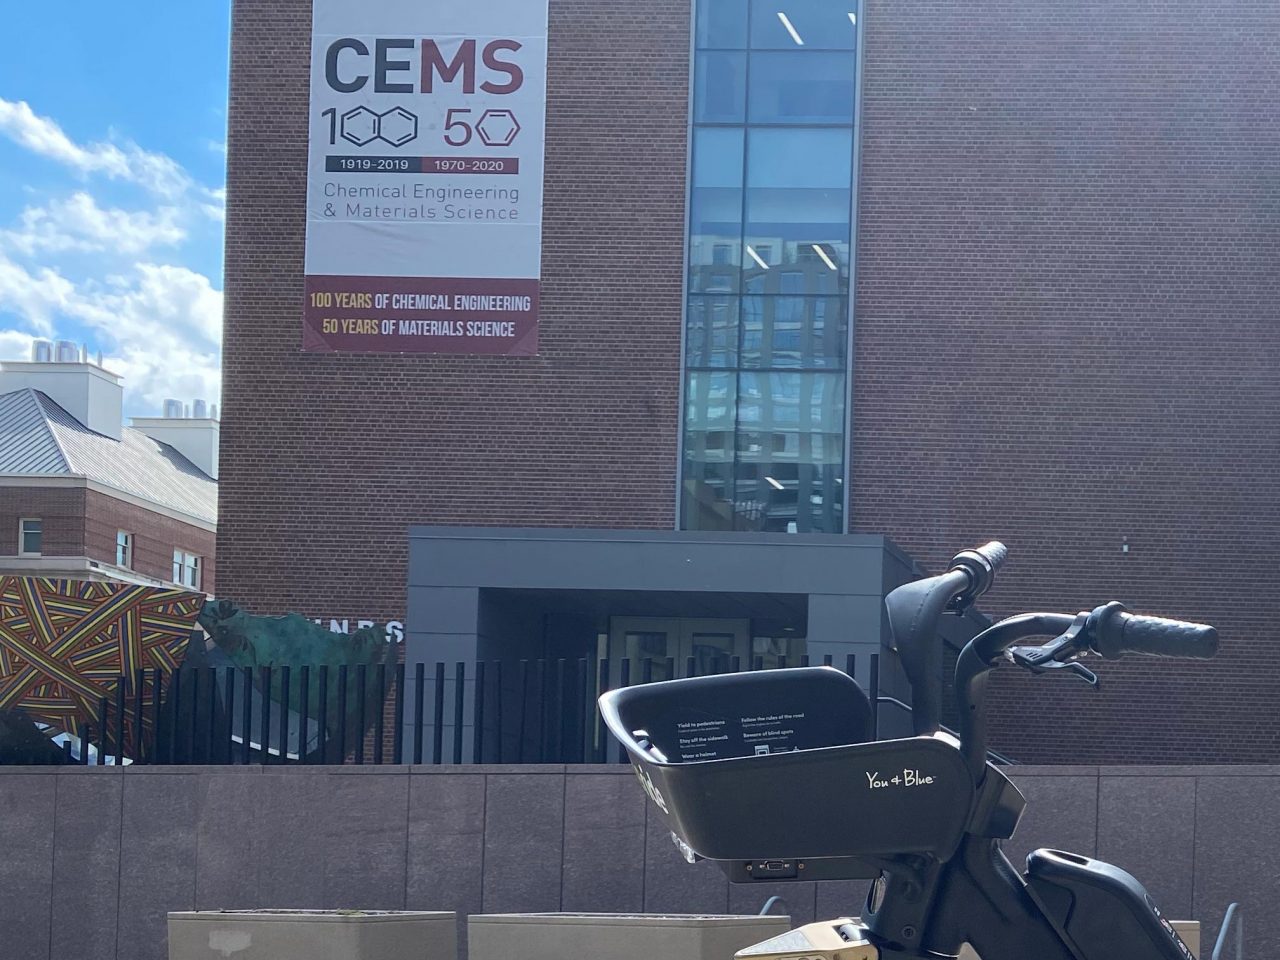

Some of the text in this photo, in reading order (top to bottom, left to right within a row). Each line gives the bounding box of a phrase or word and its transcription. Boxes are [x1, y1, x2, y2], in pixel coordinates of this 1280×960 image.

[324, 37, 524, 95] CEMS
[339, 158, 504, 172] 1919-2019 1970-2020
[323, 182, 520, 203] Chemical Engineering
[323, 202, 520, 220] & Materials Science
[310, 292, 531, 312] 100 YEARS OF CHEMICAL ENGINEERING
[322, 318, 516, 337] 50 YEARS OF MATERIALS SCIENCE
[866, 771, 889, 789] You
